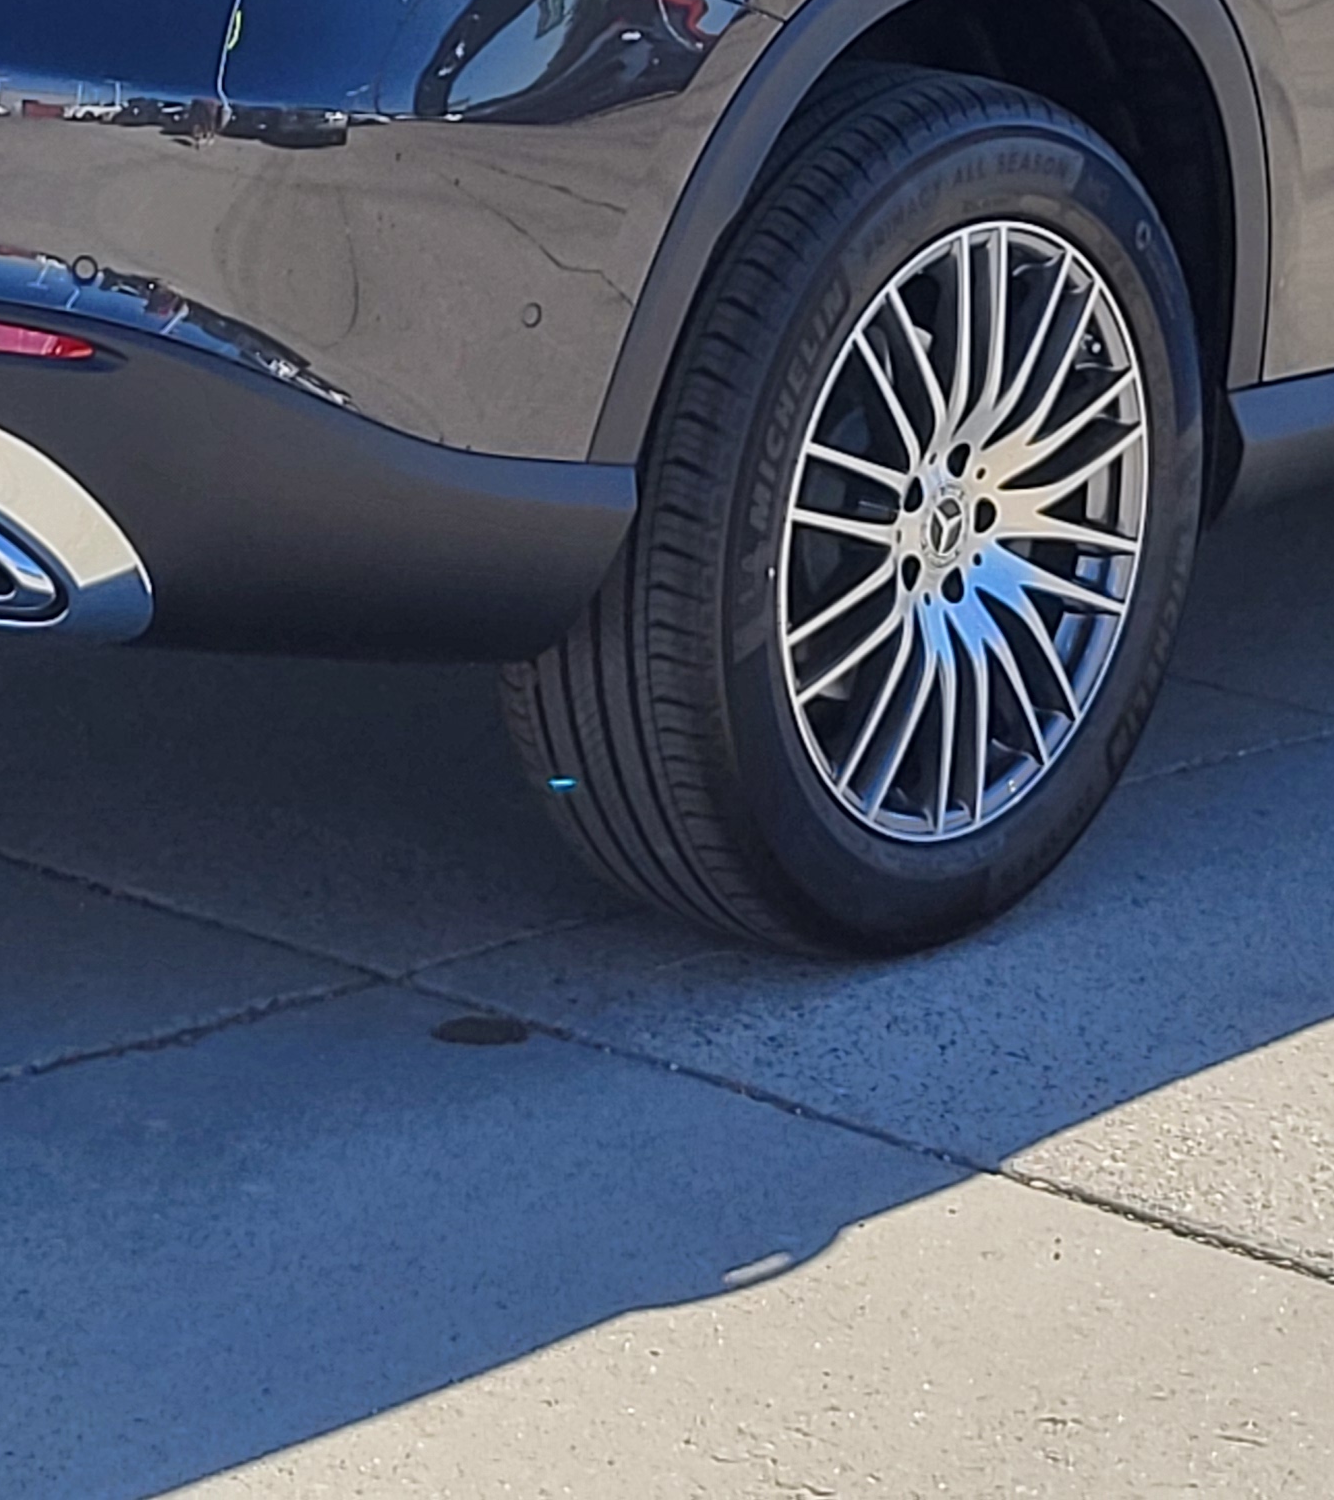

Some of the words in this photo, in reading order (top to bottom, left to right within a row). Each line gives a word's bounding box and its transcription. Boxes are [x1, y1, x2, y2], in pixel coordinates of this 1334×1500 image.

[953, 159, 987, 188] ALL
[996, 153, 1069, 180] SEASON
[748, 279, 846, 532] MICHELIN
